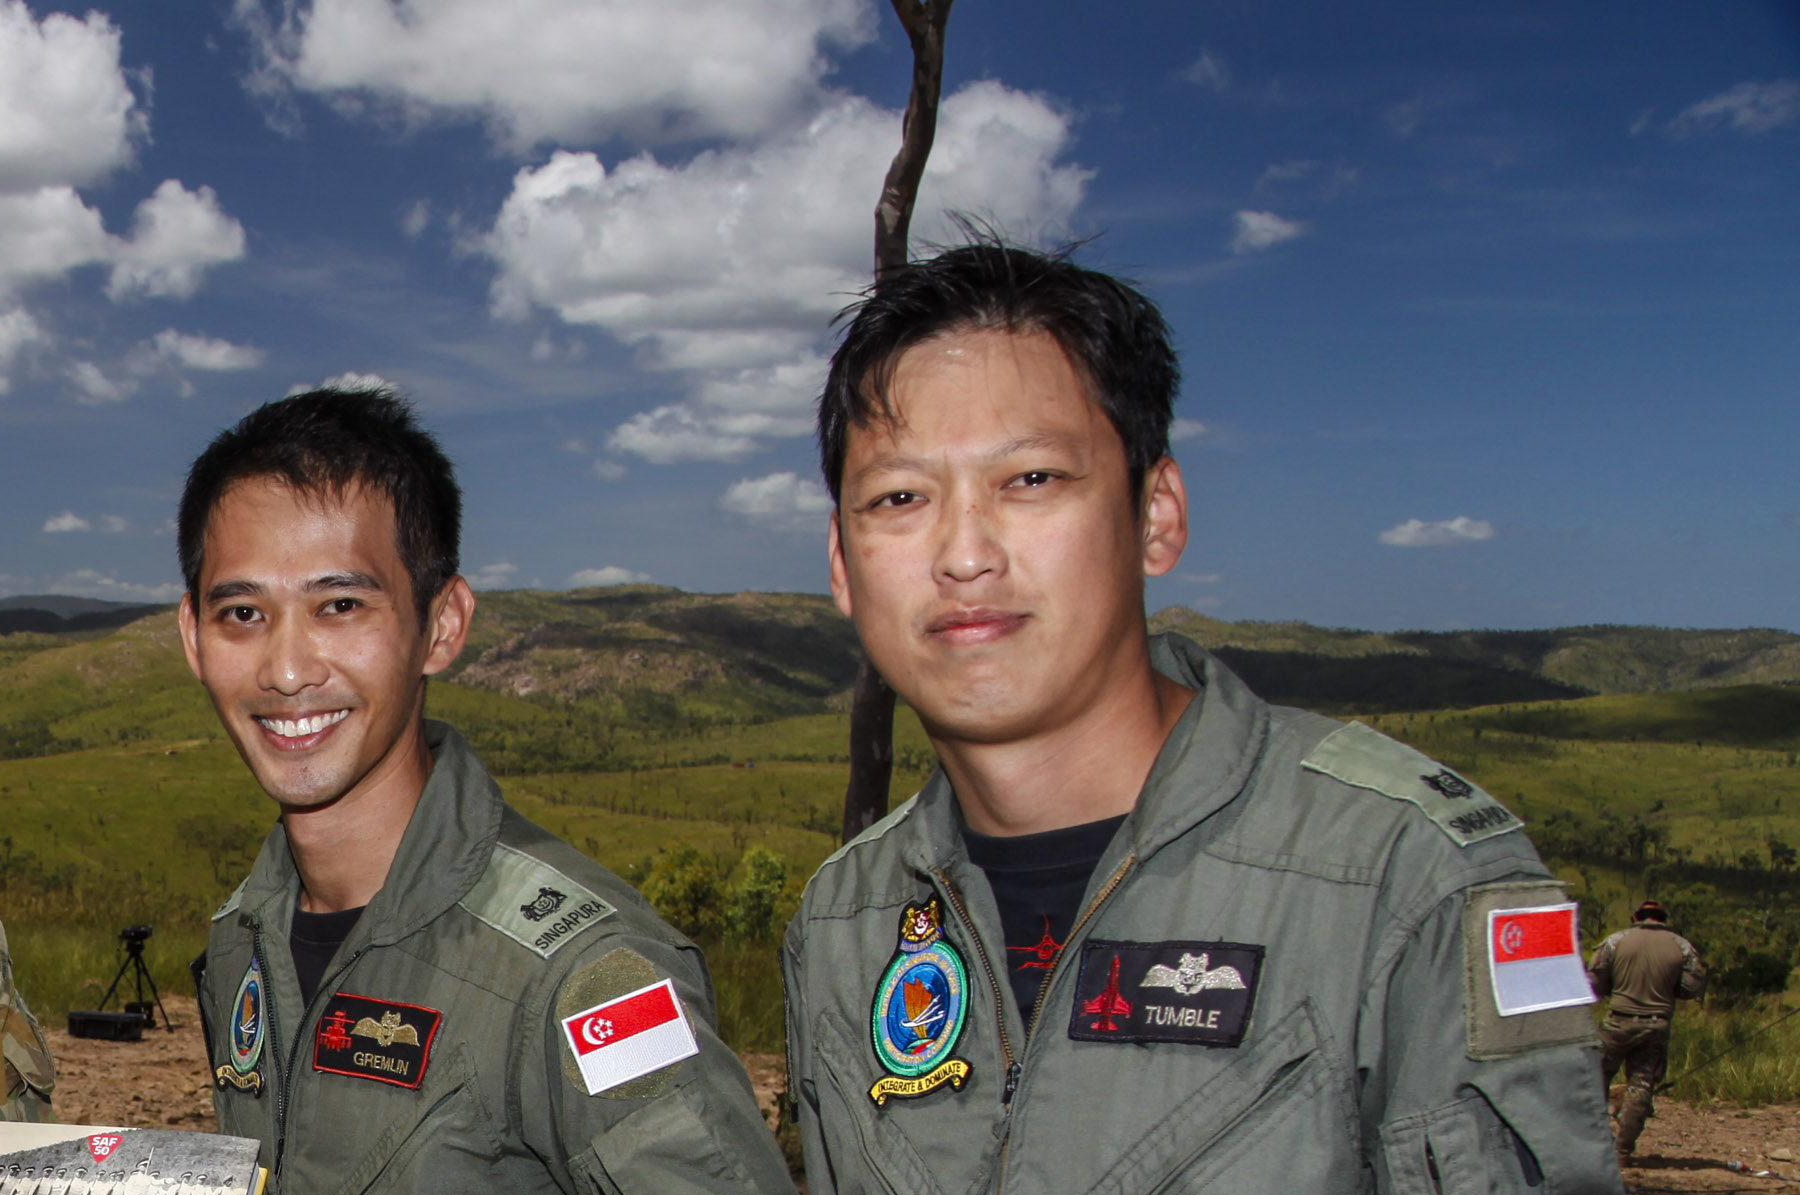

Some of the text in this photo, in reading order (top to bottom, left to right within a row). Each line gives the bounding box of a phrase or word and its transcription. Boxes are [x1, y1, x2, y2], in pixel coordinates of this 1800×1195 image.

[535, 900, 606, 949] SINGAPURA
[1145, 1005, 1221, 1028] TUMBLE
[353, 1052, 409, 1075] GREMLIN
[878, 1080, 916, 1093] INTEGRATE
[925, 1063, 961, 1089] DOMINATE
[92, 1137, 118, 1146] SAF
[94, 1146, 110, 1155] 50
